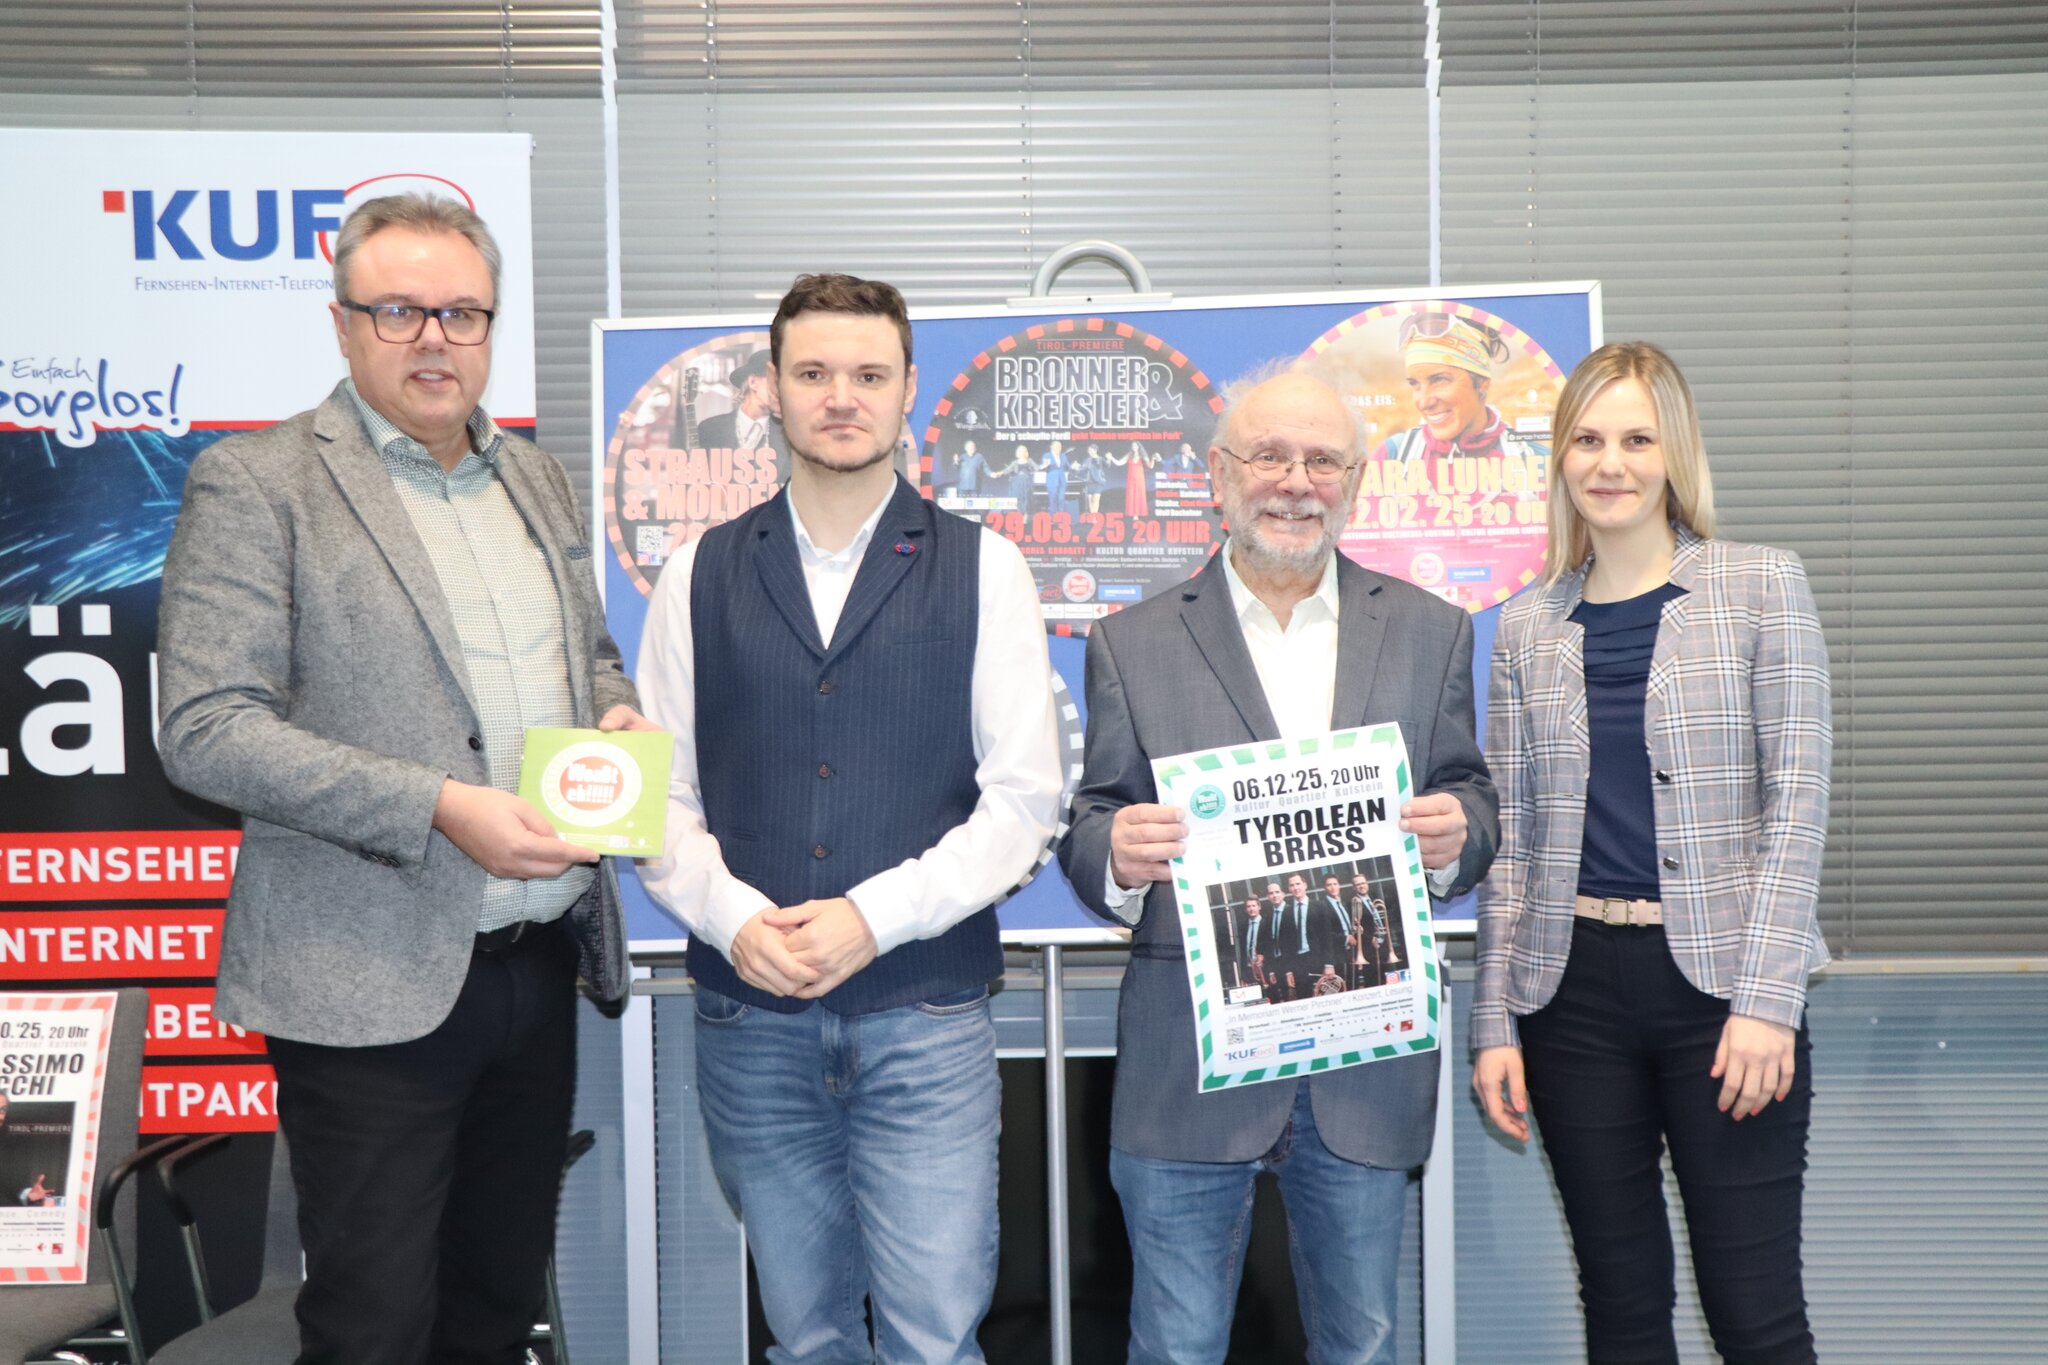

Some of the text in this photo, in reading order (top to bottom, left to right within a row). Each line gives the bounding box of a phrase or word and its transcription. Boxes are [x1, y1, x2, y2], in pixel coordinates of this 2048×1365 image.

[133, 190, 345, 260] KUF
[1037, 340, 1125, 350] TIROL-PREMIERE
[11, 357, 97, 383] Einfach
[995, 356, 1183, 421] BRONNER &
[995, 392, 1149, 429] KREISLER
[623, 448, 778, 485] STRAUSS
[1360, 455, 1552, 497] ARA LUNGE
[623, 487, 649, 521] &
[1481, 501, 1511, 526] 20
[1515, 500, 1547, 525] UH
[1133, 521, 1161, 544] 20
[1166, 520, 1210, 543] UHR
[1096, 547, 1124, 555] KULTUR
[1127, 547, 1164, 556] QUARTIER
[1168, 547, 1204, 555] KUFSTEIN
[1331, 767, 1351, 785] 20
[1353, 764, 1380, 782] Uhr
[1234, 799, 1271, 813] Kultur
[1279, 790, 1326, 806] Quartier
[1335, 781, 1384, 797] Kufstein
[1233, 797, 1386, 844] TYROLEAN
[1263, 826, 1365, 868] BRASS
[0, 925, 214, 963] NTERNET
[1237, 1008, 1281, 1023] Memoriam
[1282, 1003, 1309, 1015] Werner
[49, 1026, 65, 1039] 20
[68, 1025, 90, 1039] Uhr
[1, 1053, 85, 1075] SSIMO
[0, 1075, 56, 1096] CCHI
[140, 1080, 278, 1117] TPAK
